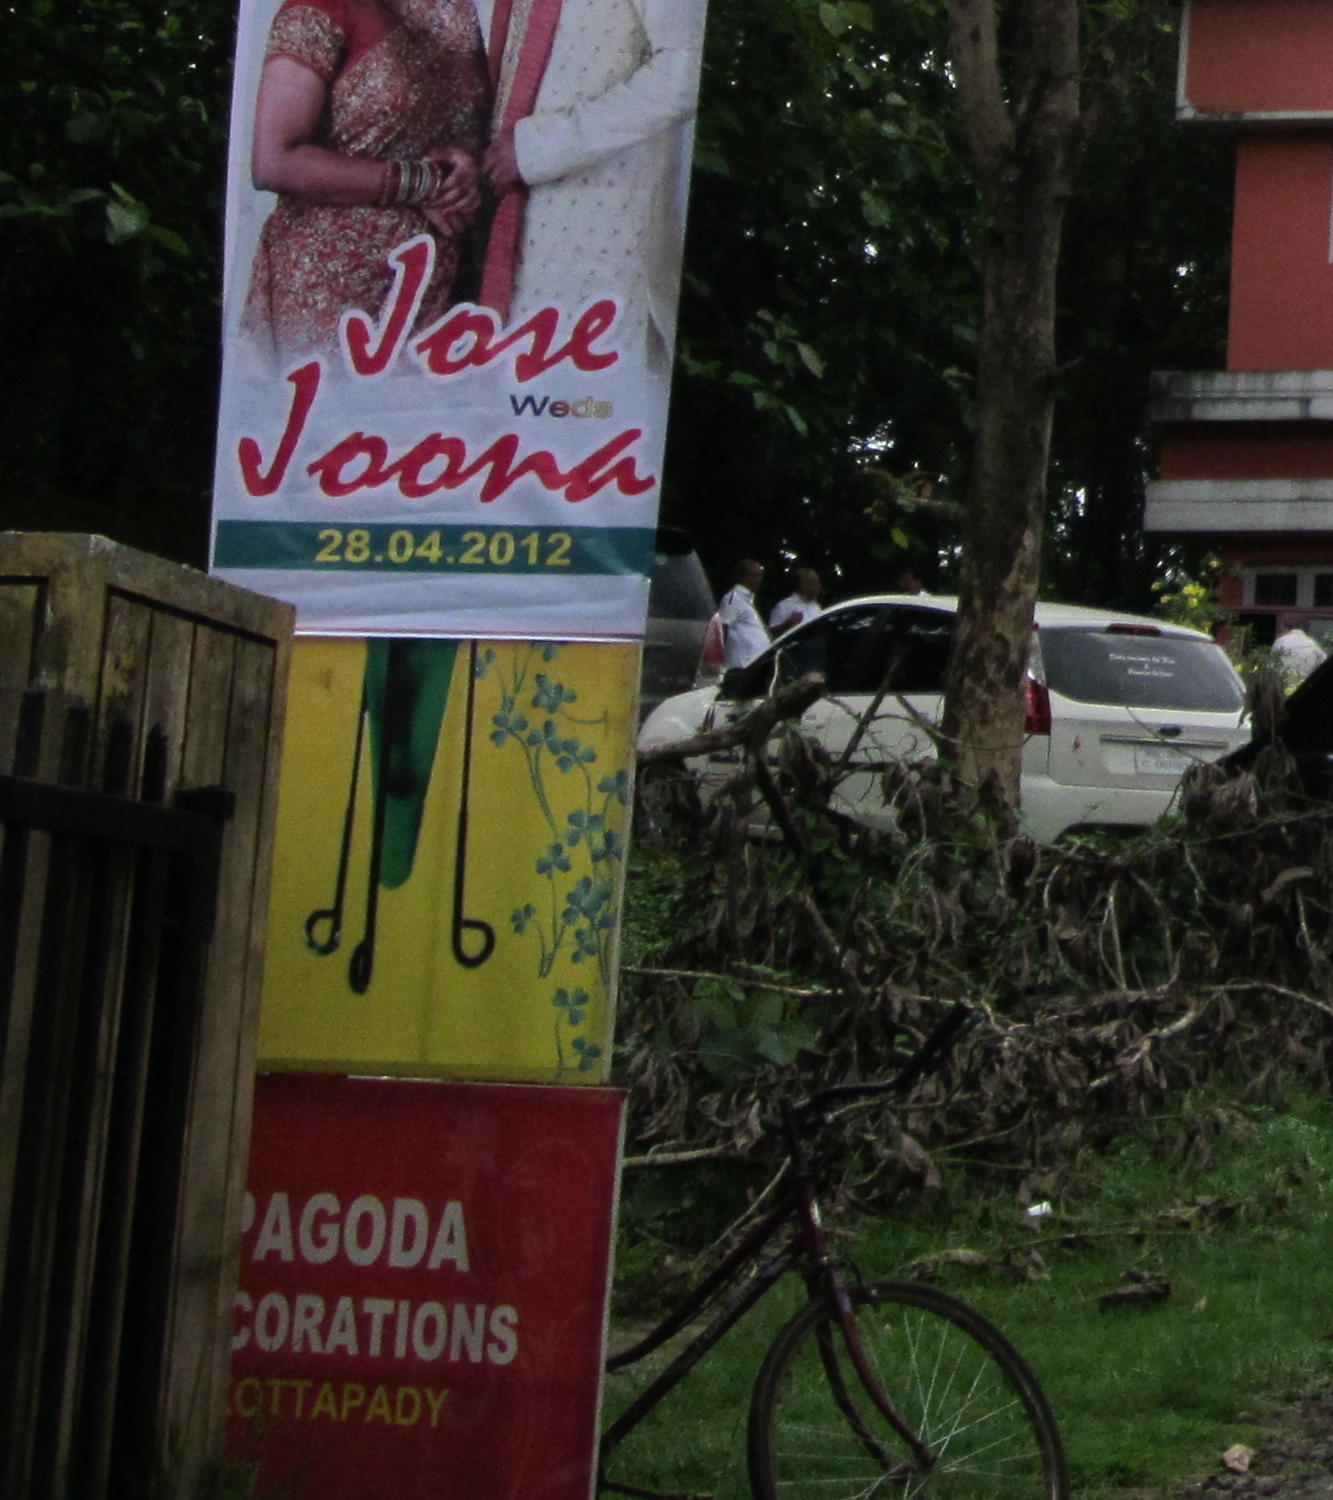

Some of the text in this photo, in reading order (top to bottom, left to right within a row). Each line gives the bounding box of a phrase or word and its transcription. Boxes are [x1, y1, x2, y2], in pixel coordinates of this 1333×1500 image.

[344, 238, 620, 384] Jose
[510, 393, 614, 420] Weds
[237, 360, 657, 504] Joona
[314, 527, 573, 567] 28.04.2012
[227, 1377, 450, 1427] OTTAPADY
